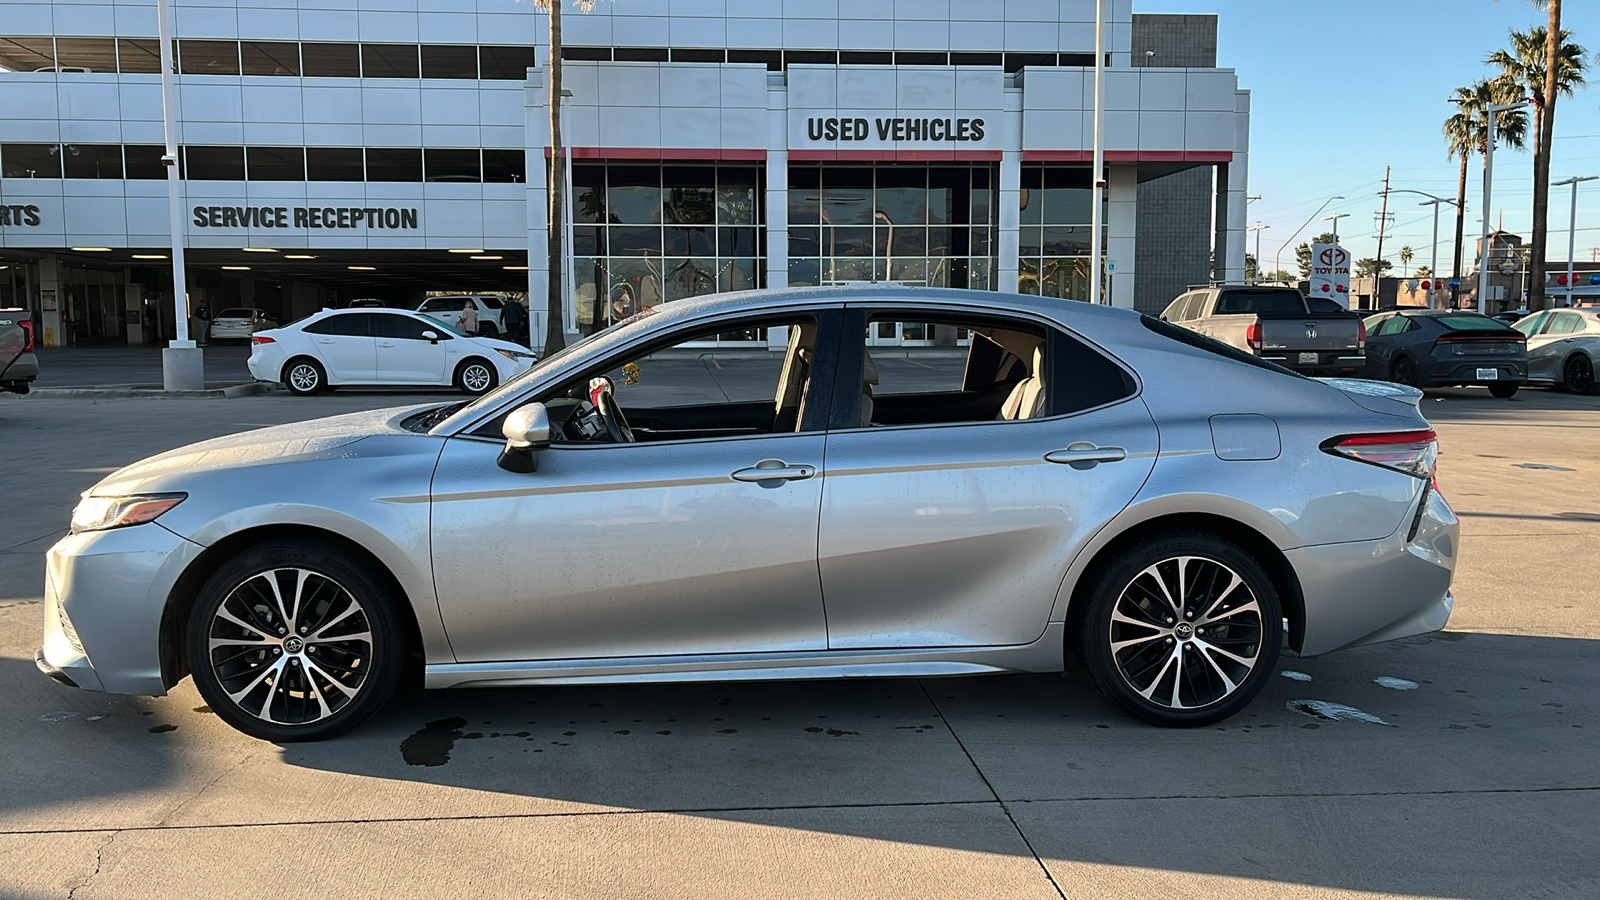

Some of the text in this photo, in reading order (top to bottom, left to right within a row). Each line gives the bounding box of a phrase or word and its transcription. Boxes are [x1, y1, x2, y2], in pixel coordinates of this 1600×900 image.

[808, 118, 985, 141] USED VEHICLES
[0, 205, 40, 226] RTS
[193, 206, 418, 229] SERVICE RECEPTION
